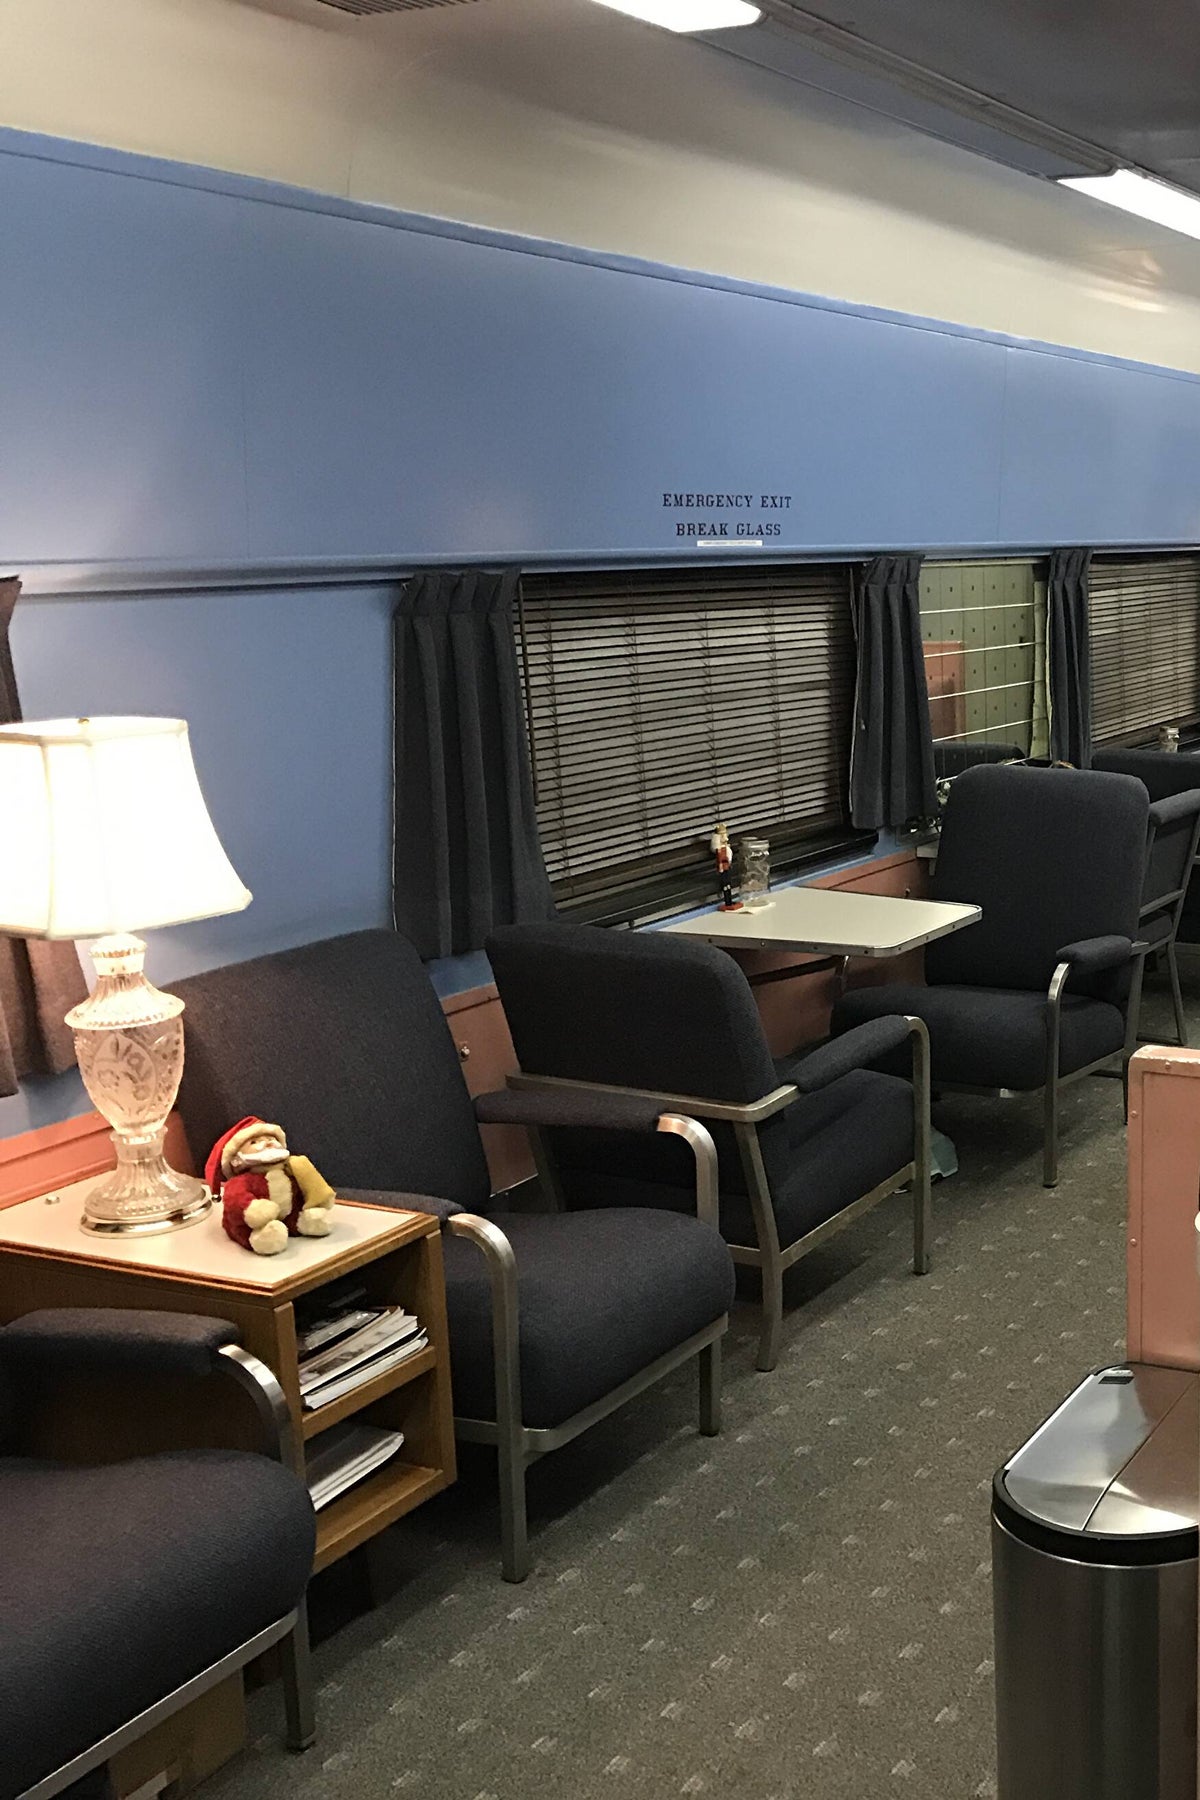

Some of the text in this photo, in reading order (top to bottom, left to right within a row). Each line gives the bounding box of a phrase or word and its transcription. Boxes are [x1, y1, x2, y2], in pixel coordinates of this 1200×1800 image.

[662, 493, 792, 509] EMERGENCY EXIT
[676, 523, 781, 536] BREAK GLASS
